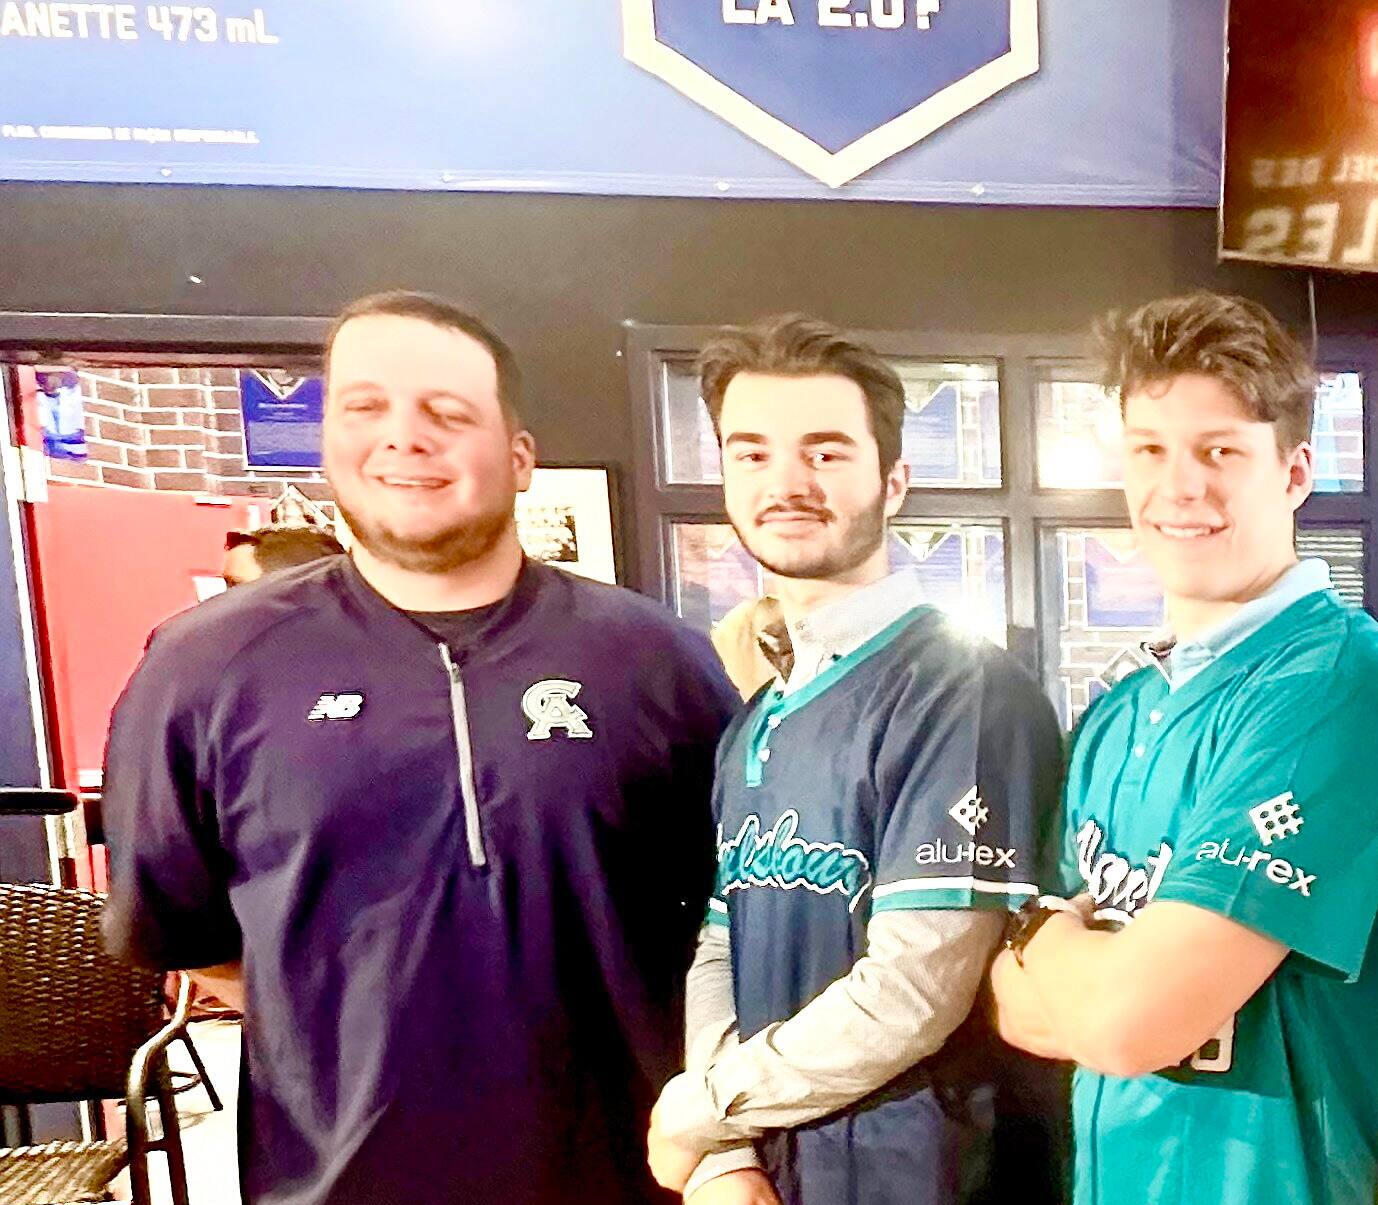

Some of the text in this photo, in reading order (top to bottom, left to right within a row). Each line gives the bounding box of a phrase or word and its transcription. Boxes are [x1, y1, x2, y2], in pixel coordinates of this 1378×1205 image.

[0, 1, 280, 44] ANETTE 473 mL
